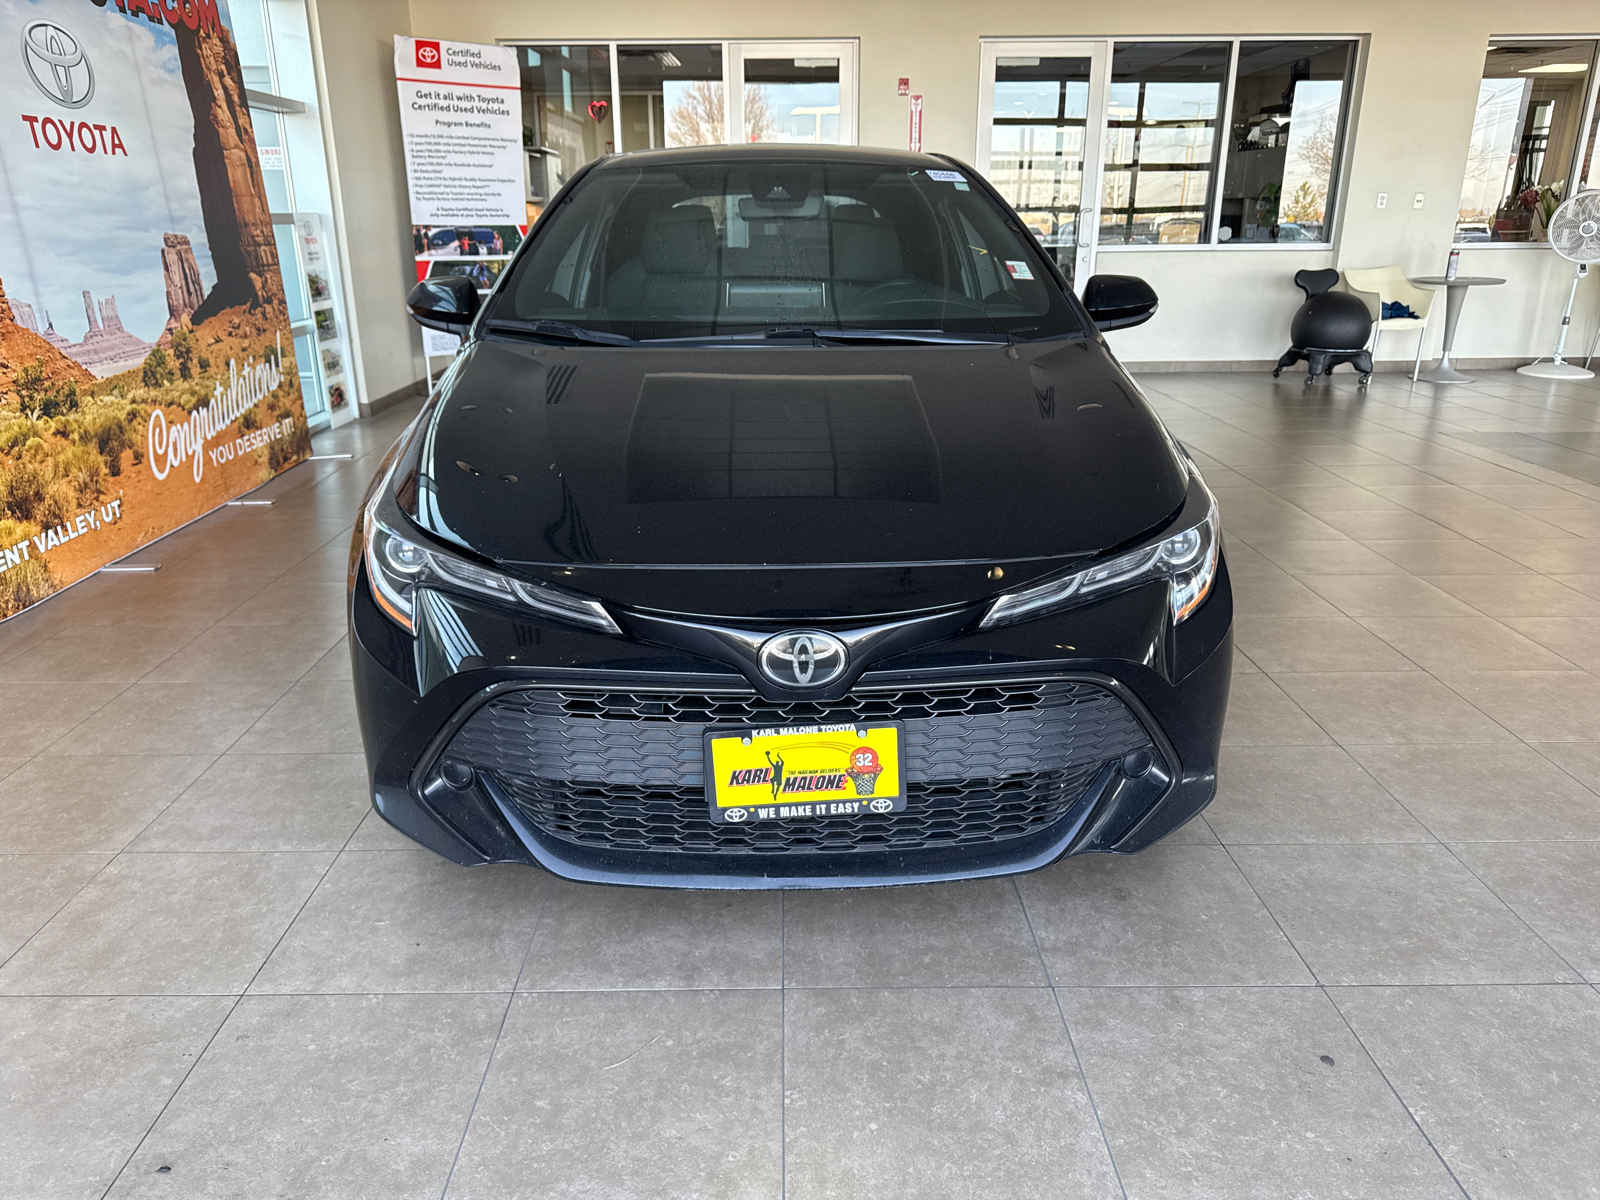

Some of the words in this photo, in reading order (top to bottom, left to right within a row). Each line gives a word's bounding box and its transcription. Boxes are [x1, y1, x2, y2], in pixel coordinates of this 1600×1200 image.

[446, 47, 481, 59] Certified
[447, 58, 468, 68] Used
[469, 60, 502, 71] Vehicles
[416, 90, 432, 100] Get
[433, 92, 441, 101] it
[442, 92, 454, 101] all
[456, 93, 476, 103] with
[477, 95, 505, 105] Toyota
[411, 102, 451, 113] Certified
[452, 104, 475, 114] Used
[476, 106, 510, 116] Vehicles
[435, 119, 464, 129] Program
[465, 120, 491, 129] Benefits
[21, 114, 128, 156] TOYOTA
[148, 330, 285, 484] Congratulations!
[208, 446, 234, 467] YOU
[236, 424, 282, 457] DESERVE
[281, 417, 296, 438] IT!
[33, 510, 101, 553] VALLEY,
[100, 499, 121, 523] UT
[752, 728, 777, 738] KARL
[779, 726, 819, 736] MALONE
[820, 724, 856, 733] TOYOTA
[855, 753, 873, 766] 32
[728, 767, 773, 787] KARL
[781, 774, 848, 794] MALONE
[758, 807, 776, 819] WE
[780, 805, 812, 817] MAKE
[816, 803, 826, 815] IT
[830, 802, 860, 814] EASY
